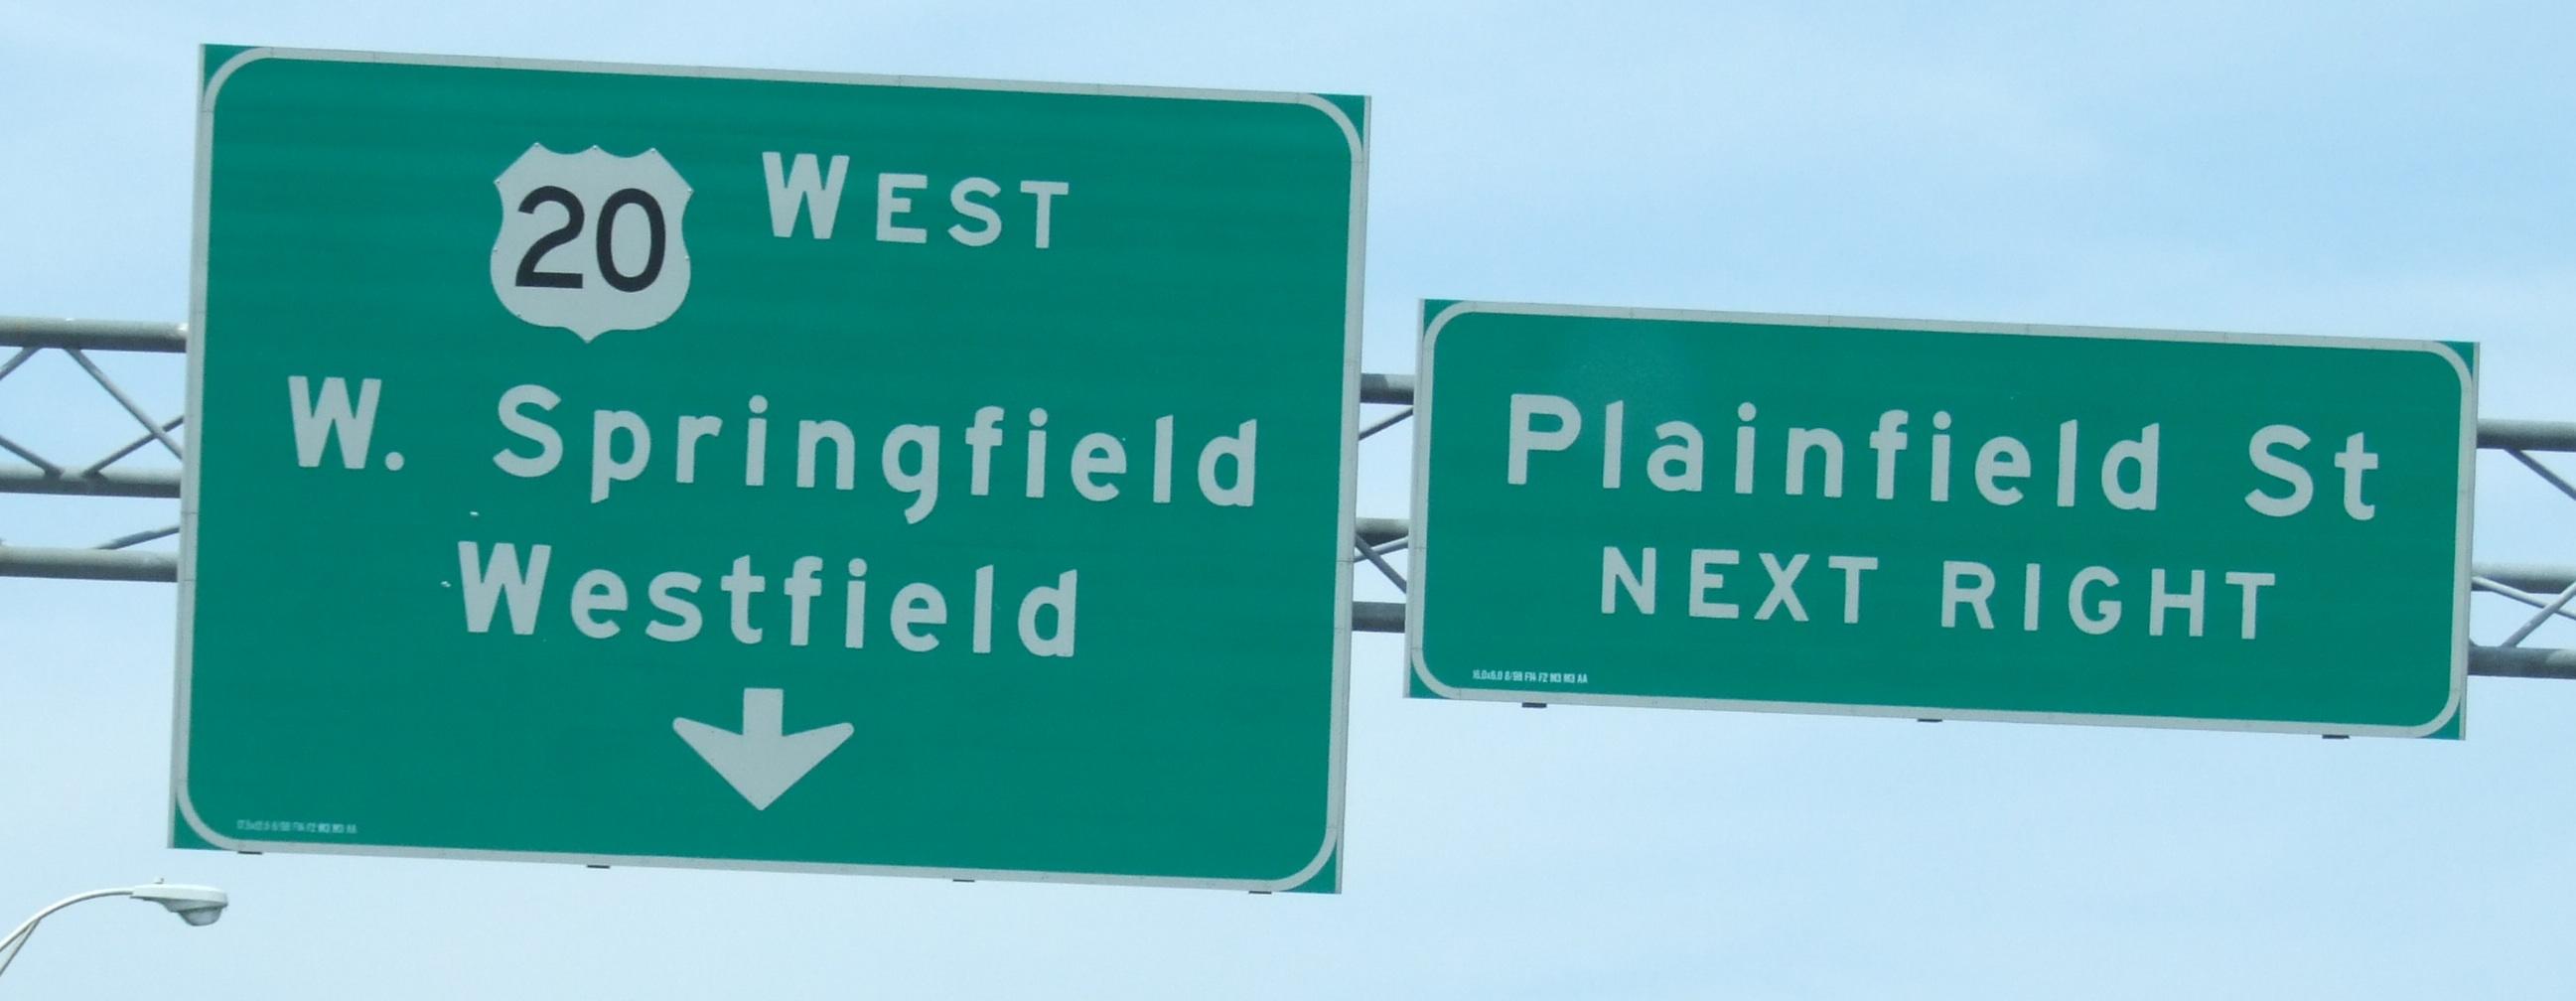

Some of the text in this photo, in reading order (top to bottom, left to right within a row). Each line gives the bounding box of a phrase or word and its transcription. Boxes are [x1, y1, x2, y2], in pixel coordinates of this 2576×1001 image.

[514, 185, 666, 293] 20
[762, 151, 1070, 249] WEST
[288, 375, 1257, 524] W. Springfield
[1507, 393, 2378, 520] Plainfield St
[458, 540, 1077, 657] Westfield
[1601, 546, 2276, 640] NEXT RIGHT
